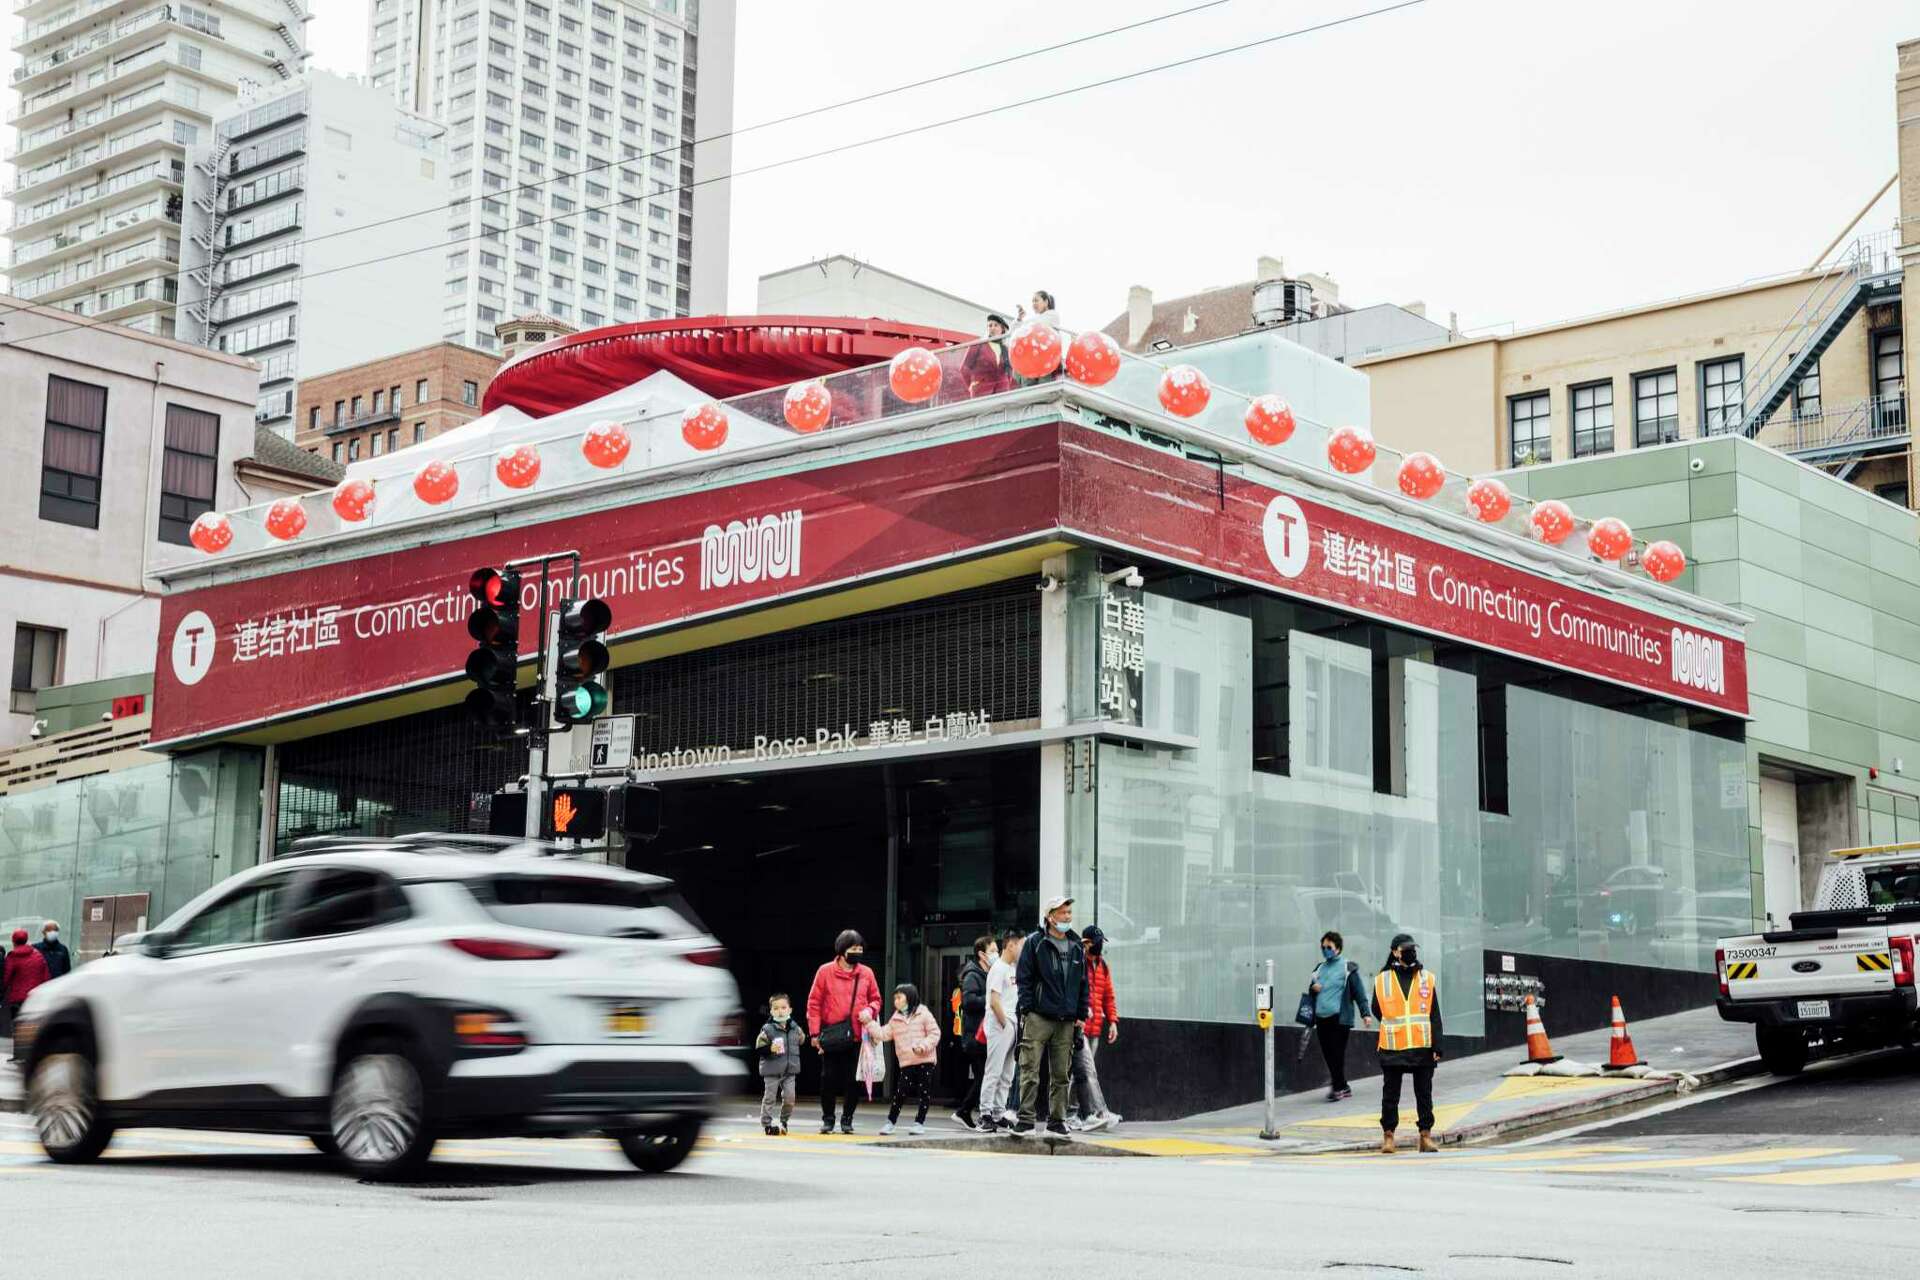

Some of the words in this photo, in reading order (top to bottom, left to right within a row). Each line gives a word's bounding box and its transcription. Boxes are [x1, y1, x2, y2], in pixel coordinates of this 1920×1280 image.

[355, 584, 482, 639] Connectin
[521, 551, 685, 611] ommunities
[1428, 564, 1541, 639] Connecting
[1547, 601, 1662, 665] Communities
[754, 734, 808, 762] Rose
[815, 723, 858, 754] Pak
[1726, 947, 1777, 960] 73500347
